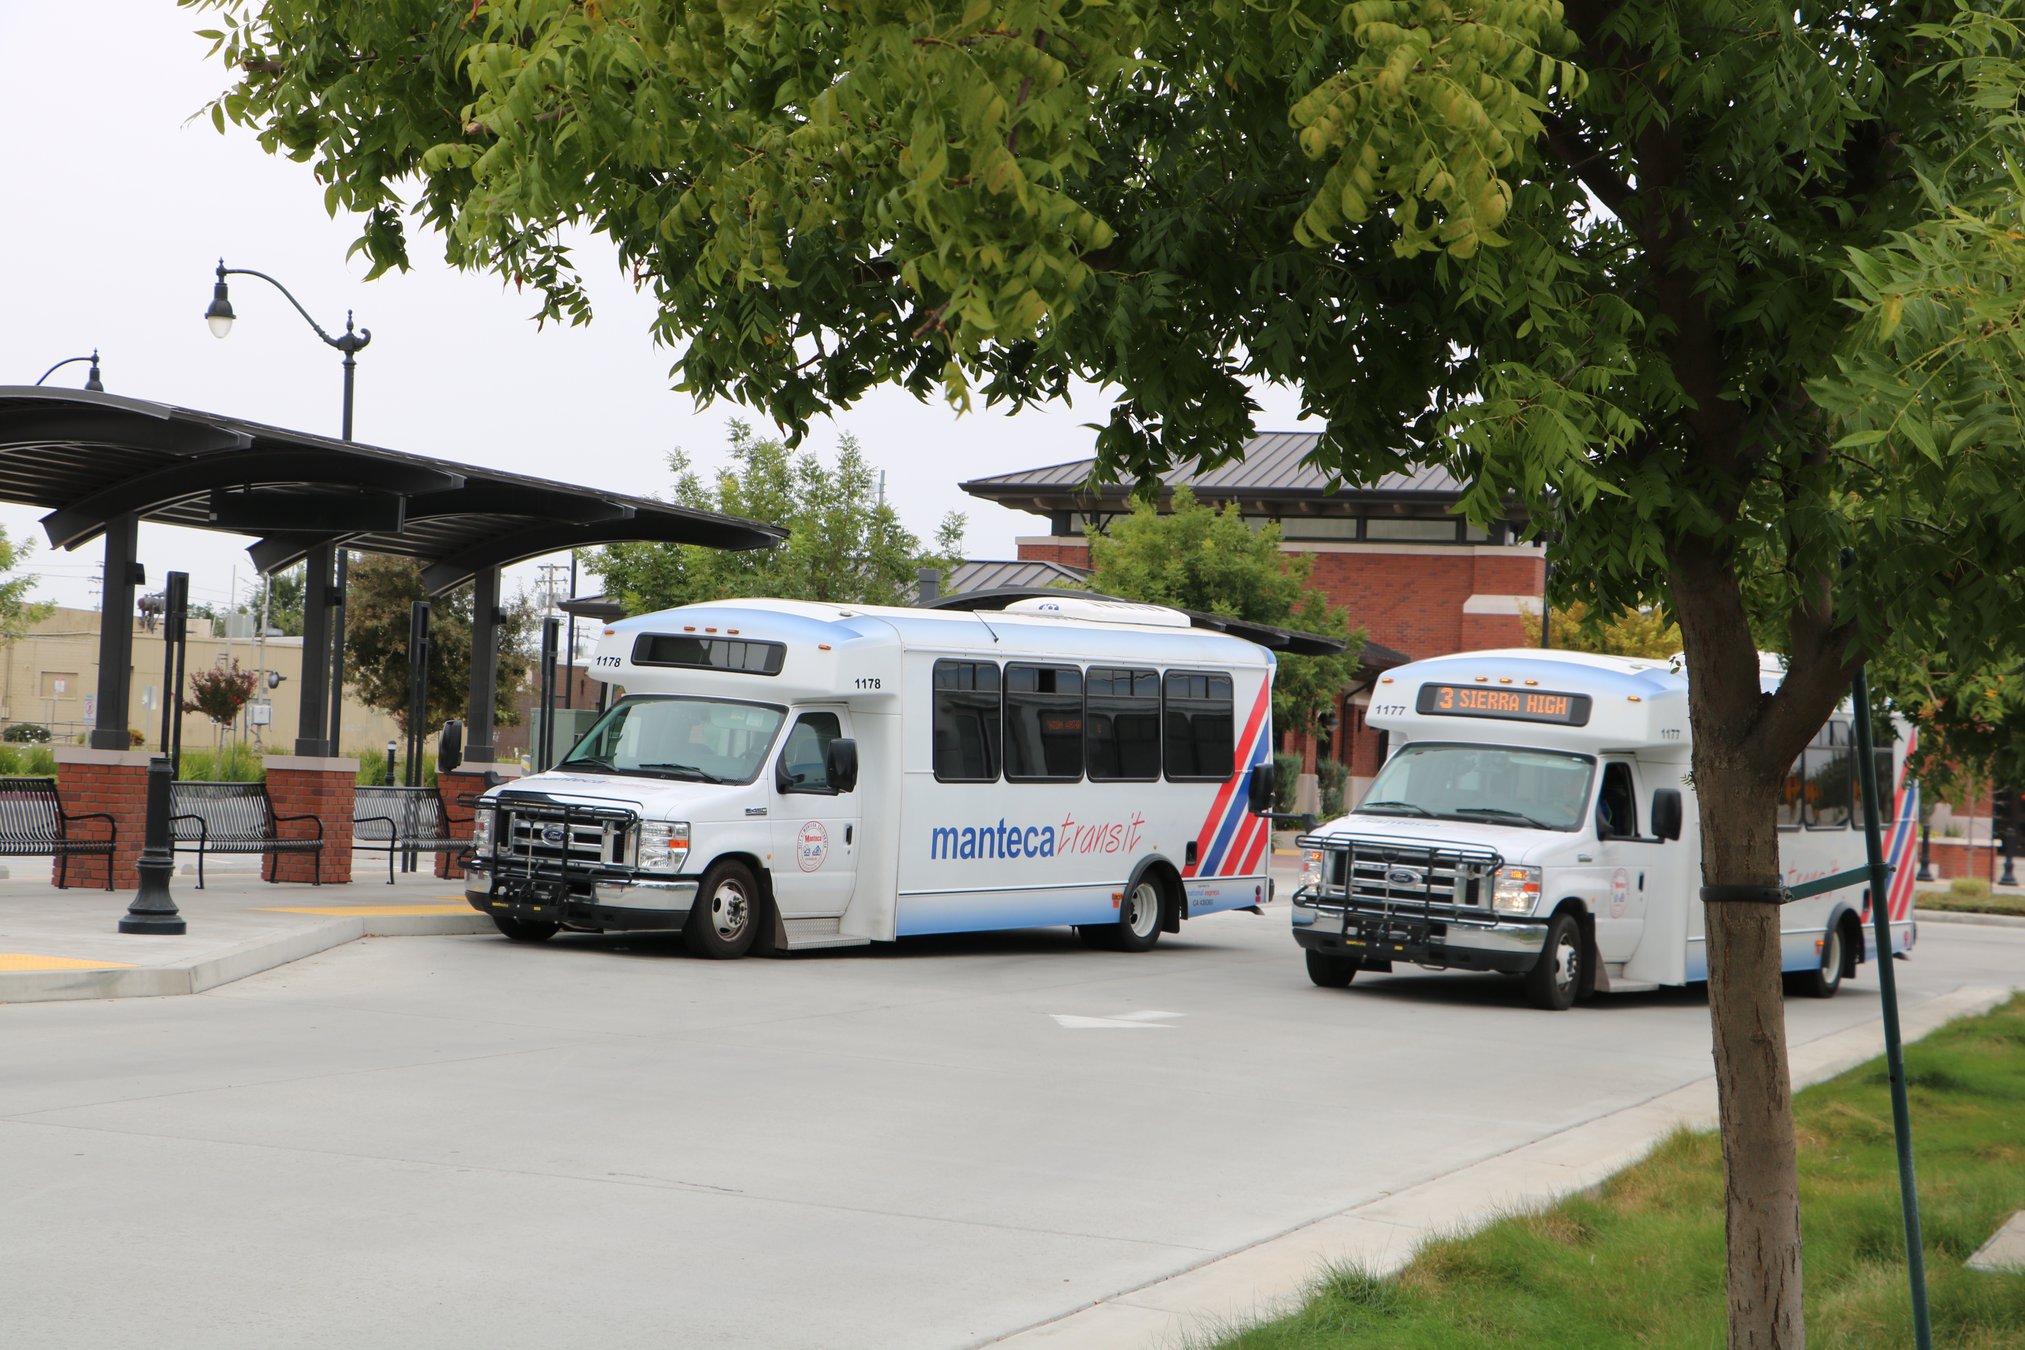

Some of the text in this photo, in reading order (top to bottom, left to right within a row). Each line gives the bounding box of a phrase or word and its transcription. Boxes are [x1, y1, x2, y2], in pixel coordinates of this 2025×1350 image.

[596, 655, 622, 668] 1178
[854, 678, 882, 690] 1178
[1439, 687, 1568, 716] 3 SIERRA HIGH
[1375, 704, 1407, 716] 1177
[1661, 728, 1681, 740] 1177
[930, 811, 1146, 860] manteca transit
